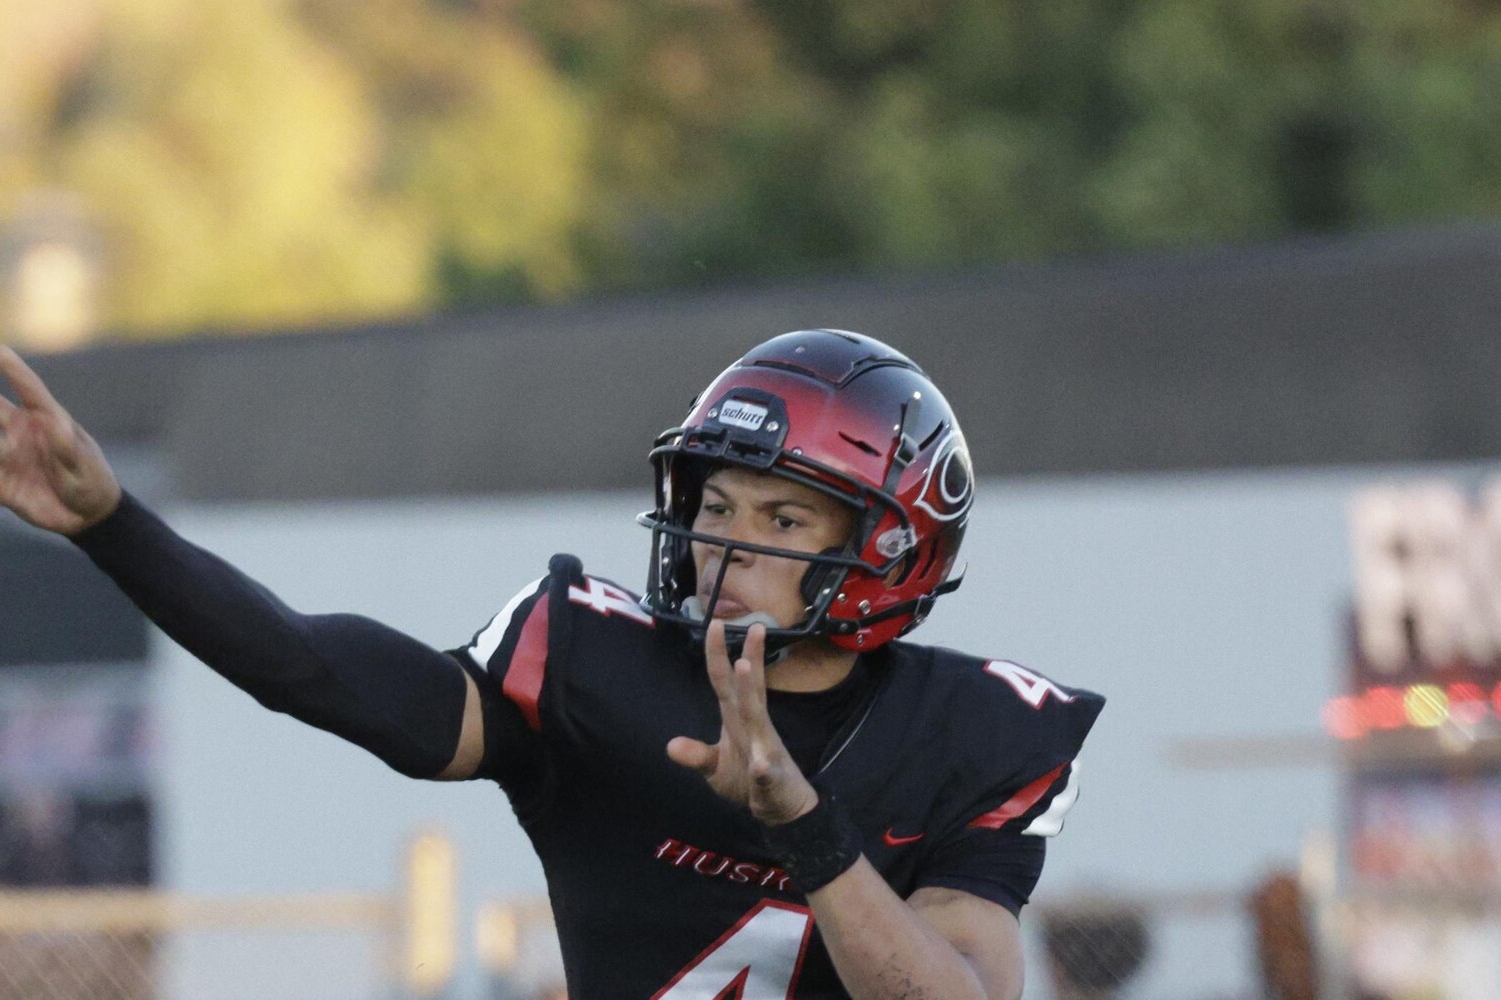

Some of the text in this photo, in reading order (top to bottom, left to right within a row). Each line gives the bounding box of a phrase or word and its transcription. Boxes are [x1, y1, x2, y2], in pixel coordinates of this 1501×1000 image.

[567, 574, 657, 630] 4
[982, 658, 1081, 712] 4
[655, 838, 796, 894] HUSK
